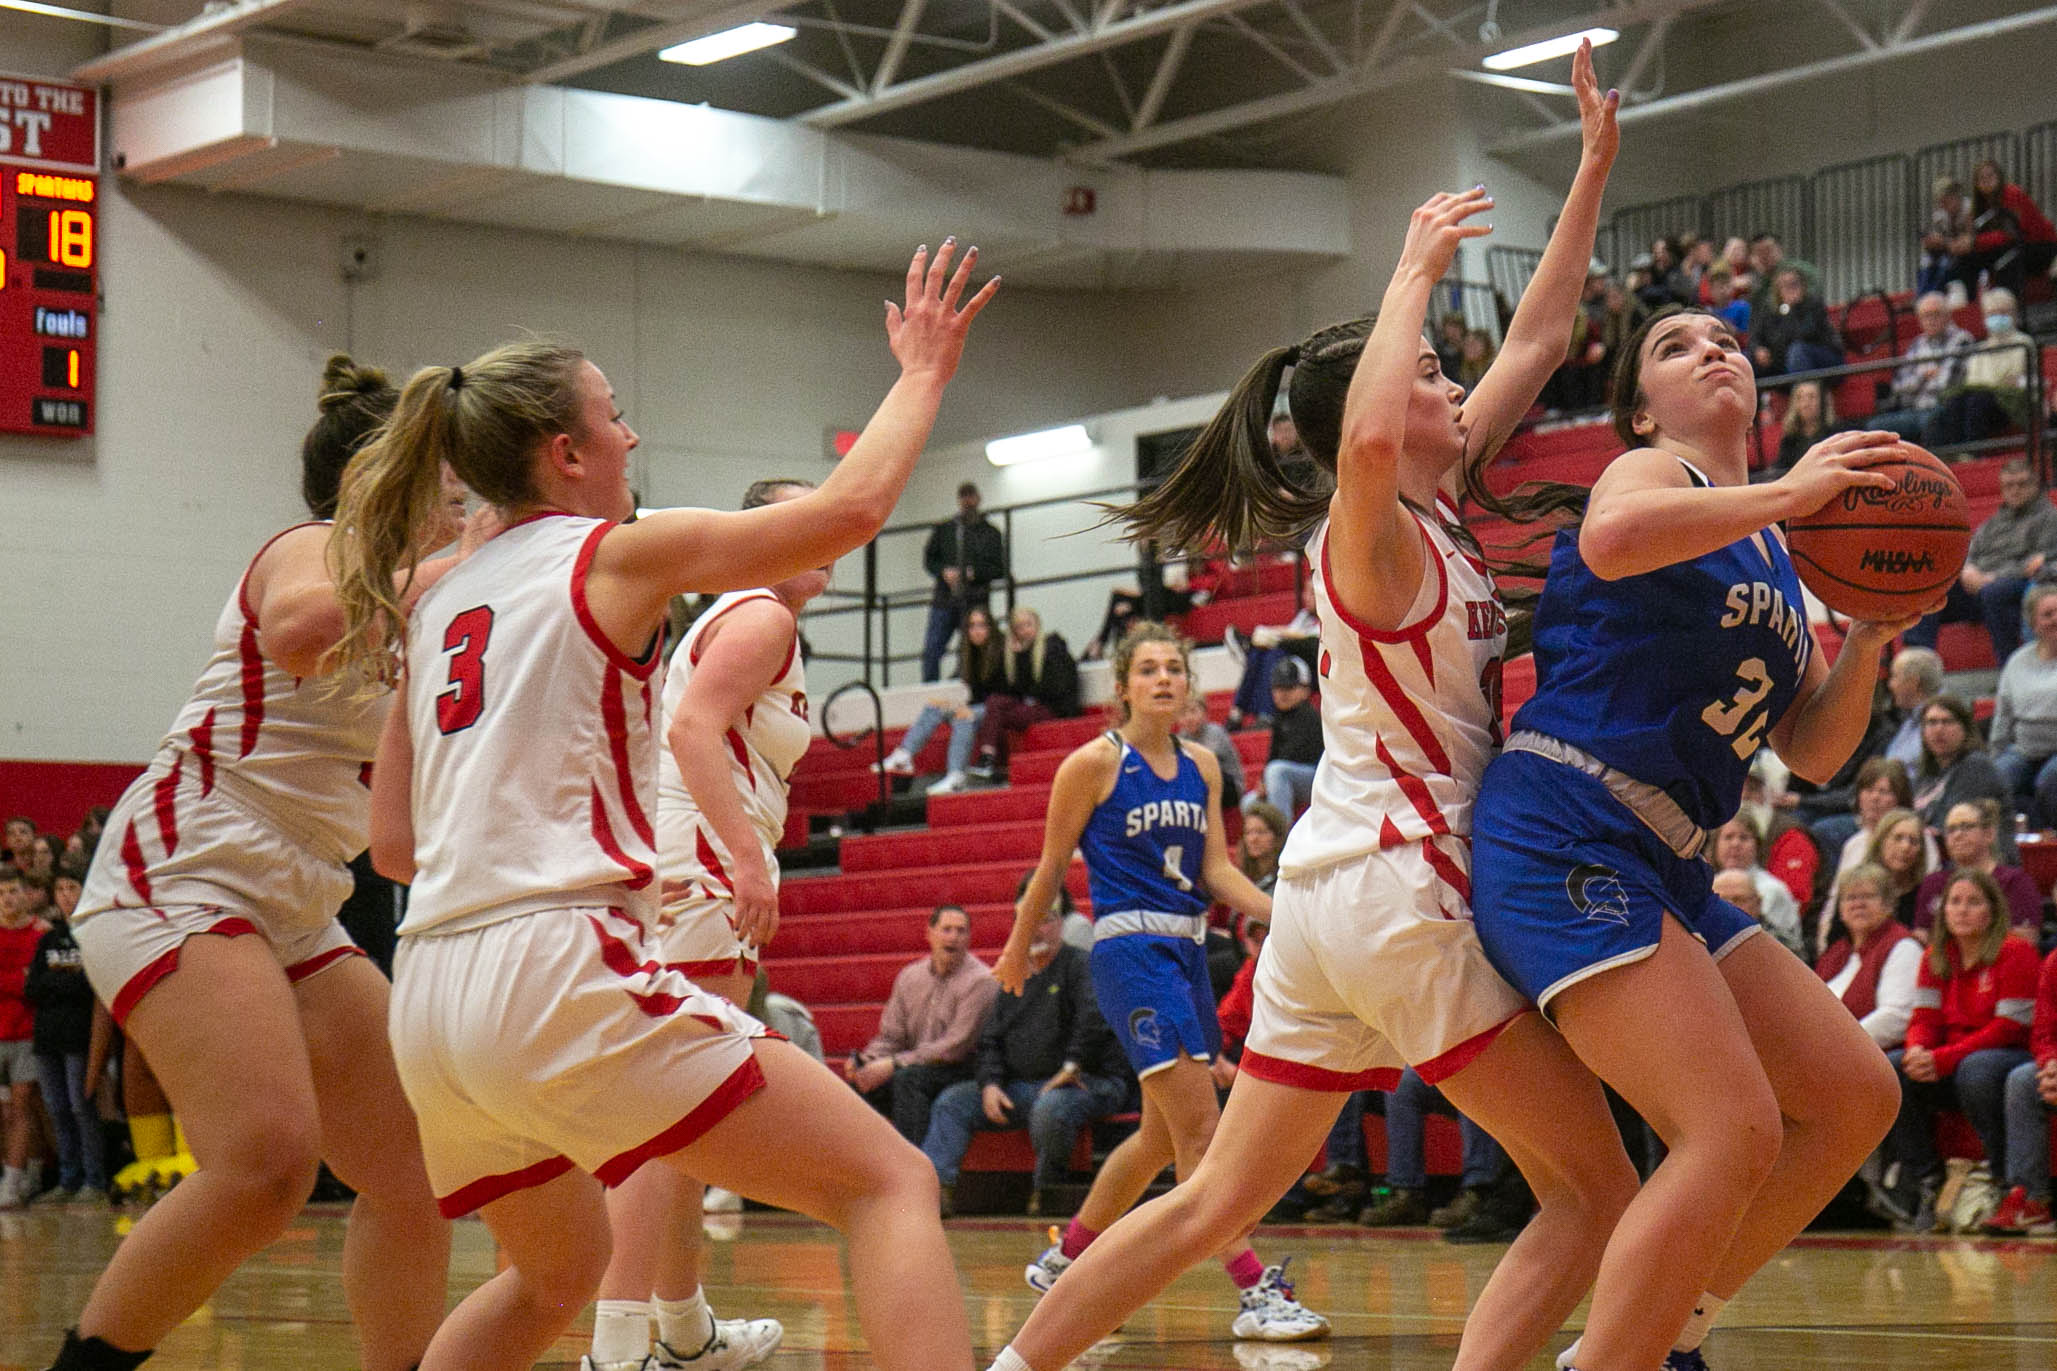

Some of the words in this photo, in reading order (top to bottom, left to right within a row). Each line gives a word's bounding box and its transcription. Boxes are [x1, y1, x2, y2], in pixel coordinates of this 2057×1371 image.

[34, 86, 84, 113] THE
[49, 209, 93, 268] 18
[68, 349, 79, 389] 1
[436, 604, 495, 735] 3
